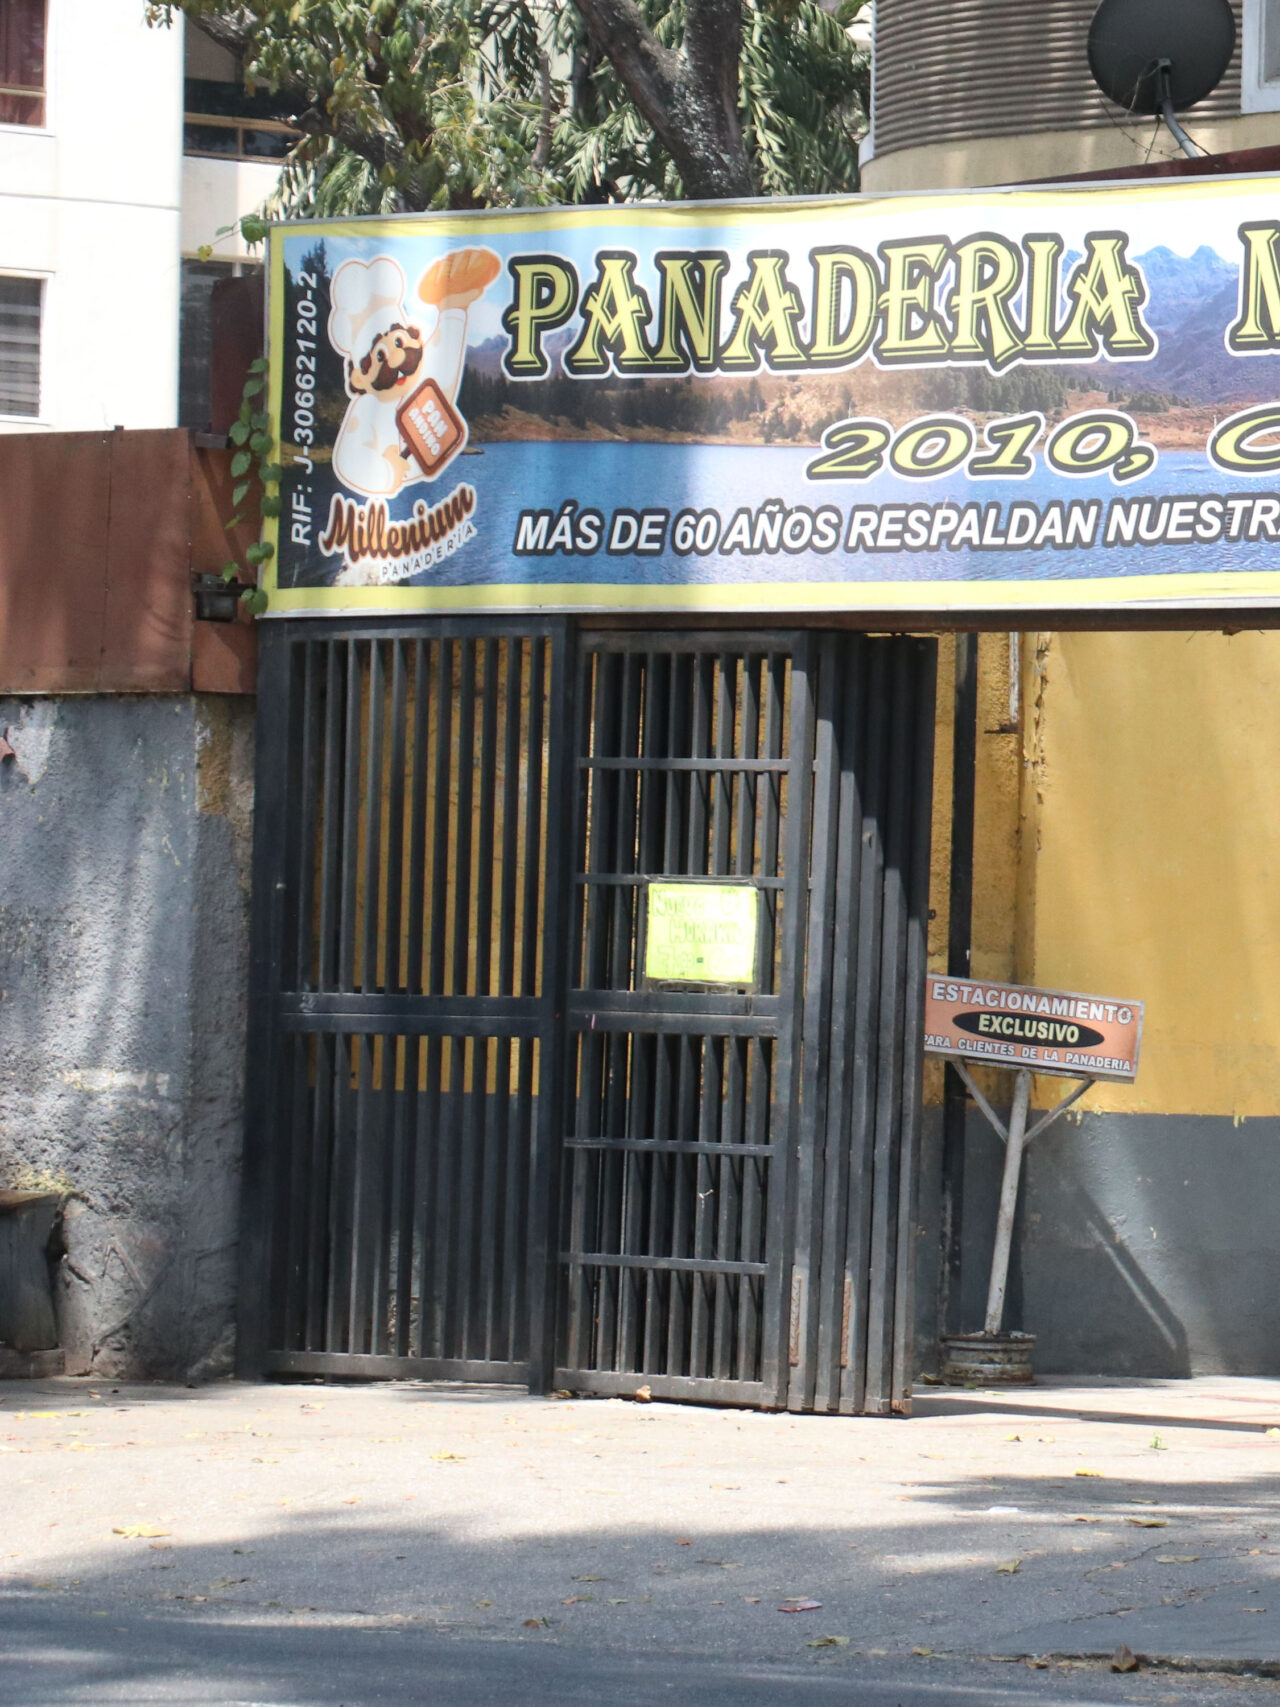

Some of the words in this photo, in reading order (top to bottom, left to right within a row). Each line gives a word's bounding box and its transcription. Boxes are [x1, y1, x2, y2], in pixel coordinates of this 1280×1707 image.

[504, 230, 1152, 376] PANADERIA
[292, 271, 318, 475] J-30662120-2
[408, 407, 441, 456] ANDINO
[421, 400, 449, 438] PAN
[807, 411, 1154, 482] 2010,
[291, 485, 313, 547] RIF:
[321, 486, 473, 561] Millenium
[515, 501, 601, 553] MÁS
[608, 513, 663, 552] DE
[673, 512, 718, 551] 60
[724, 500, 838, 552] AÑOS
[847, 503, 1099, 548] RESPALDAN
[932, 981, 1134, 1025] ESTACIONAMIENTO
[977, 1013, 1080, 1044] EXCLUSIVO
[924, 1033, 951, 1048] PARA
[958, 1038, 1016, 1056] CLIENTES
[1021, 1047, 1037, 1059] DE
[1043, 1049, 1059, 1062] LA
[1065, 1052, 1132, 1072] PANADERIA
